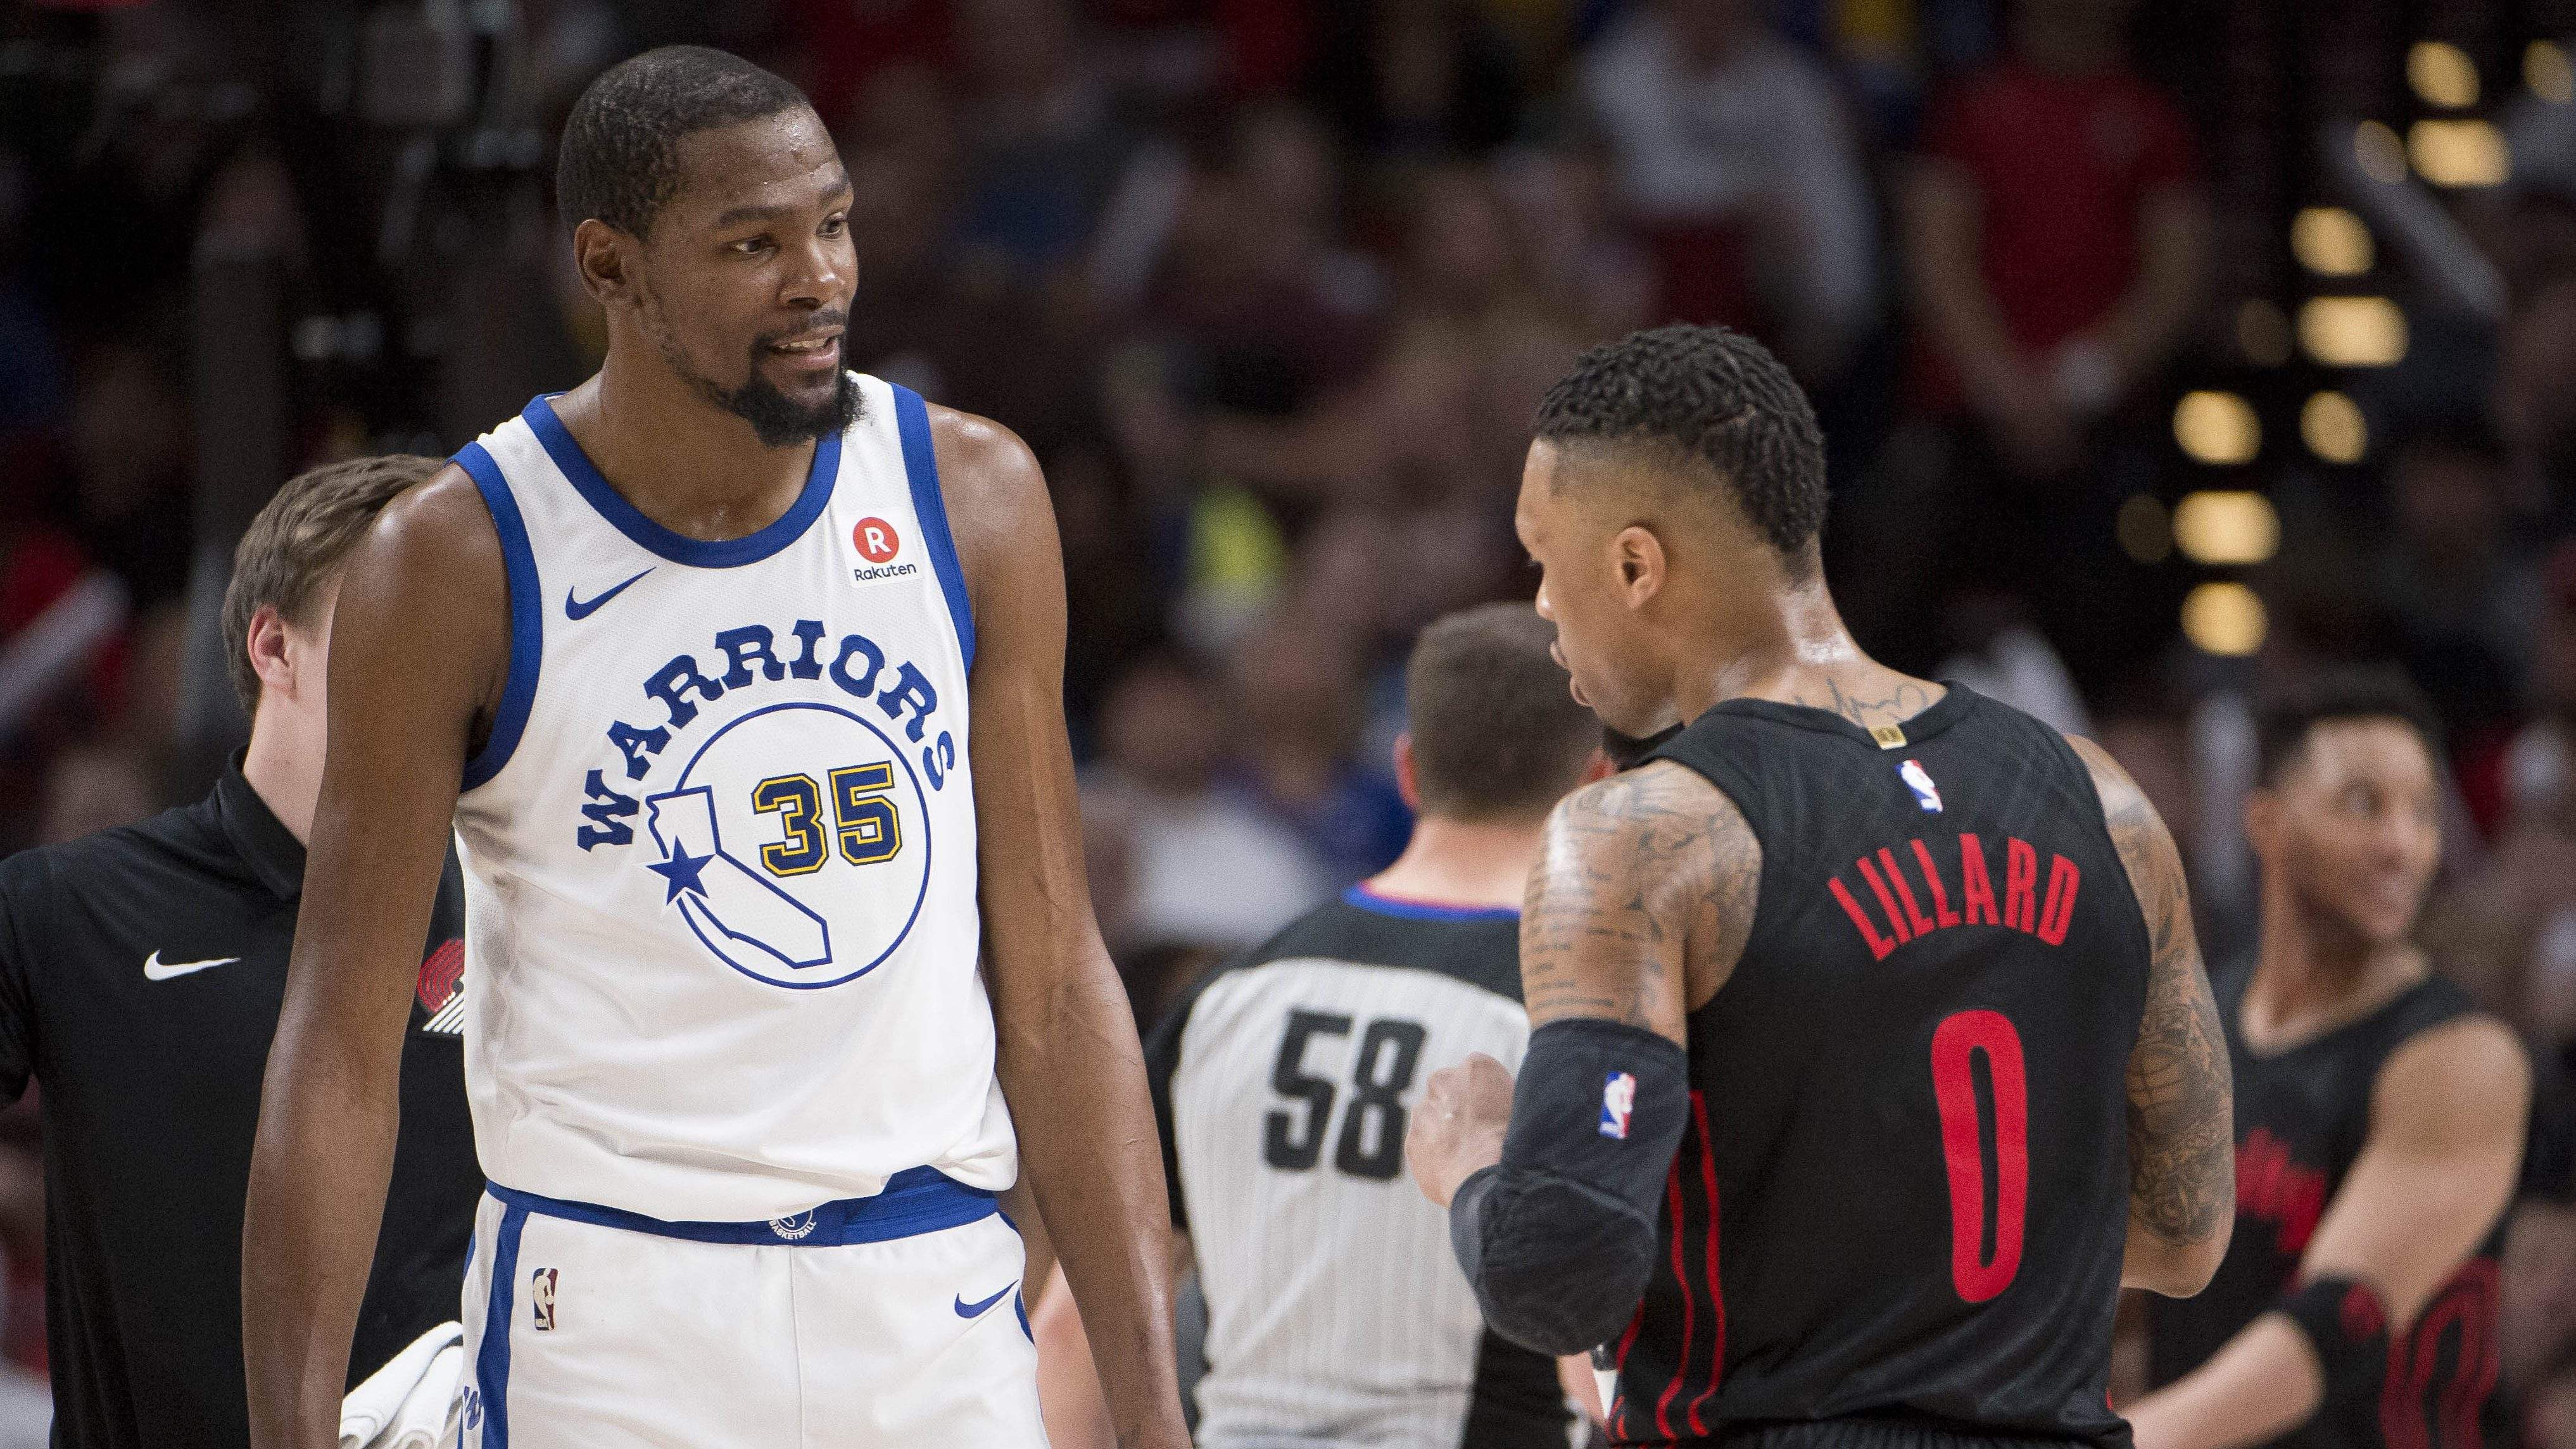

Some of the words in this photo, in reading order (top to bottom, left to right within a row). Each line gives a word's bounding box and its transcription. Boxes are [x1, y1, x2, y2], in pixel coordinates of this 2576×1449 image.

[854, 563, 917, 581] Rakuten
[864, 527, 892, 555] R
[577, 620, 955, 853] WARRIORS
[751, 760, 902, 878] 35
[1829, 833, 2080, 961] LILLARD
[1263, 1008, 1427, 1180] 58
[1931, 1010, 2028, 1303] 0
